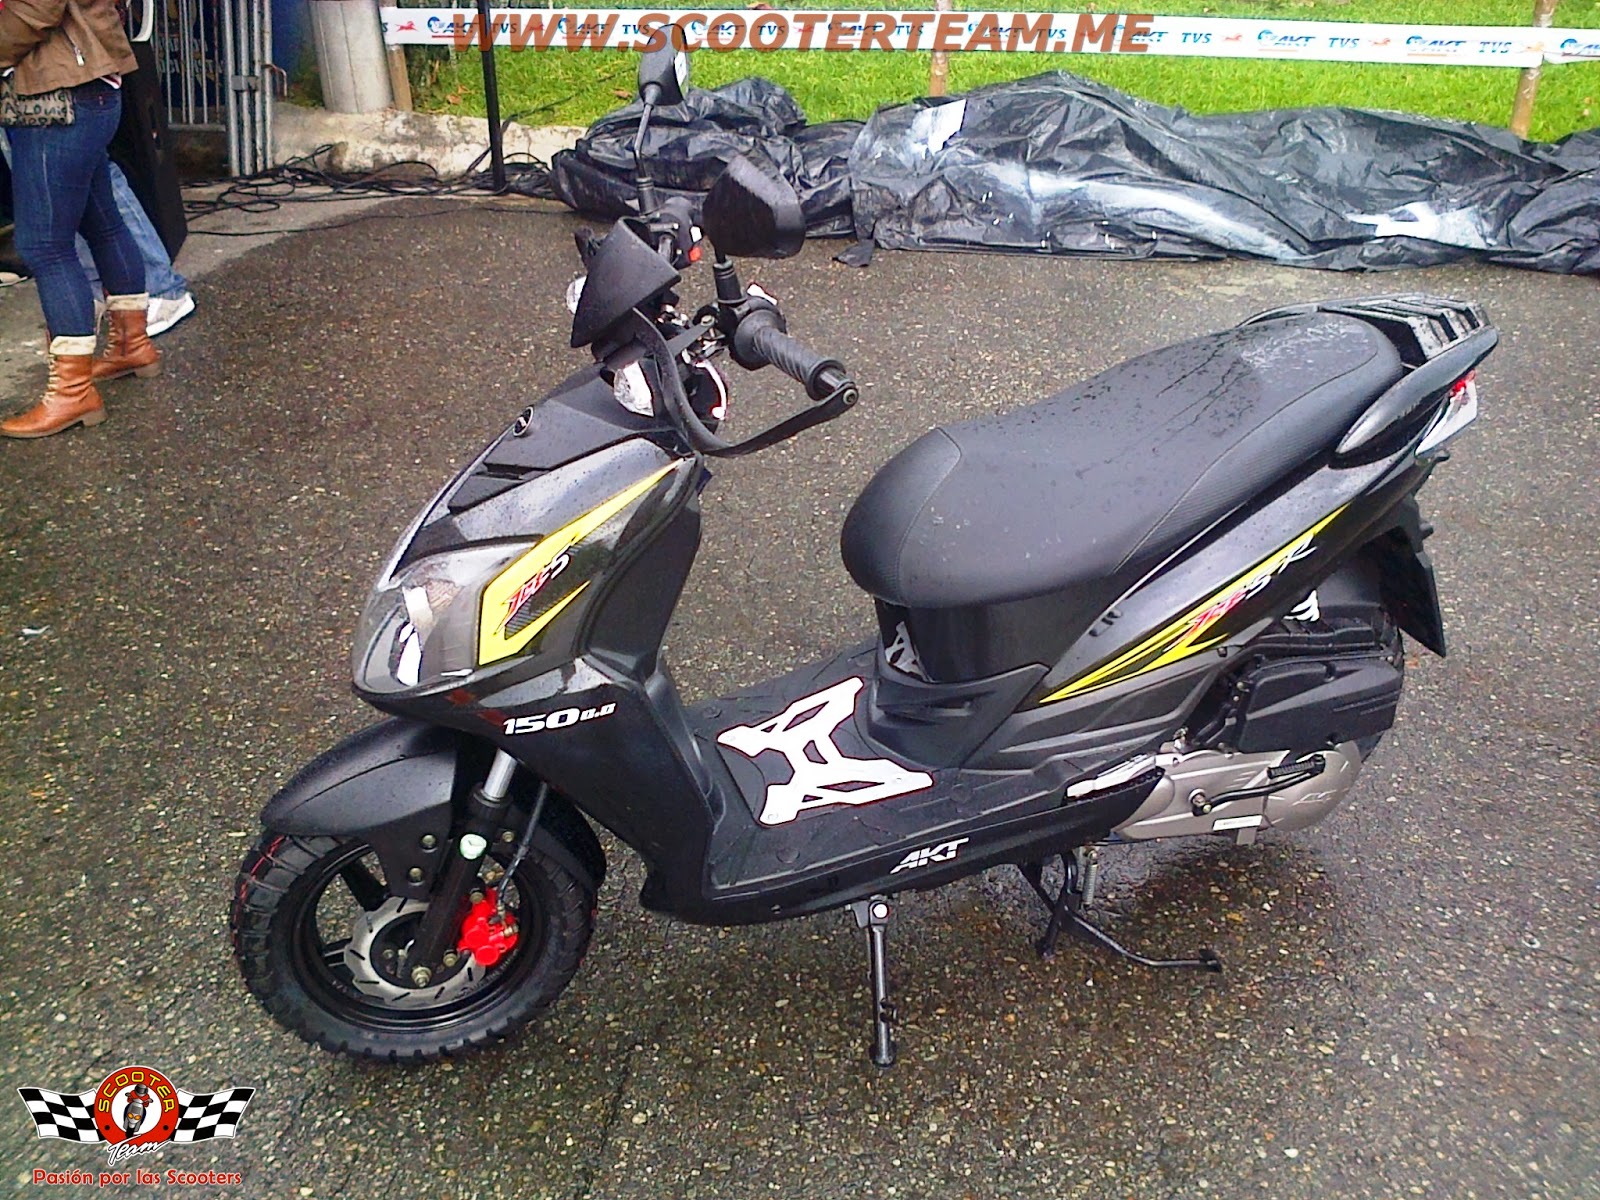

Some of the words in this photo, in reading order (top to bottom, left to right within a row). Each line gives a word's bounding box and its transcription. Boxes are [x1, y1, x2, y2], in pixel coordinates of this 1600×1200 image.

[1181, 32, 1212, 43] TVS
[1328, 37, 1360, 48] TVS
[1479, 41, 1512, 54] TVS
[503, 708, 580, 735] 150
[890, 837, 970, 874] AKT
